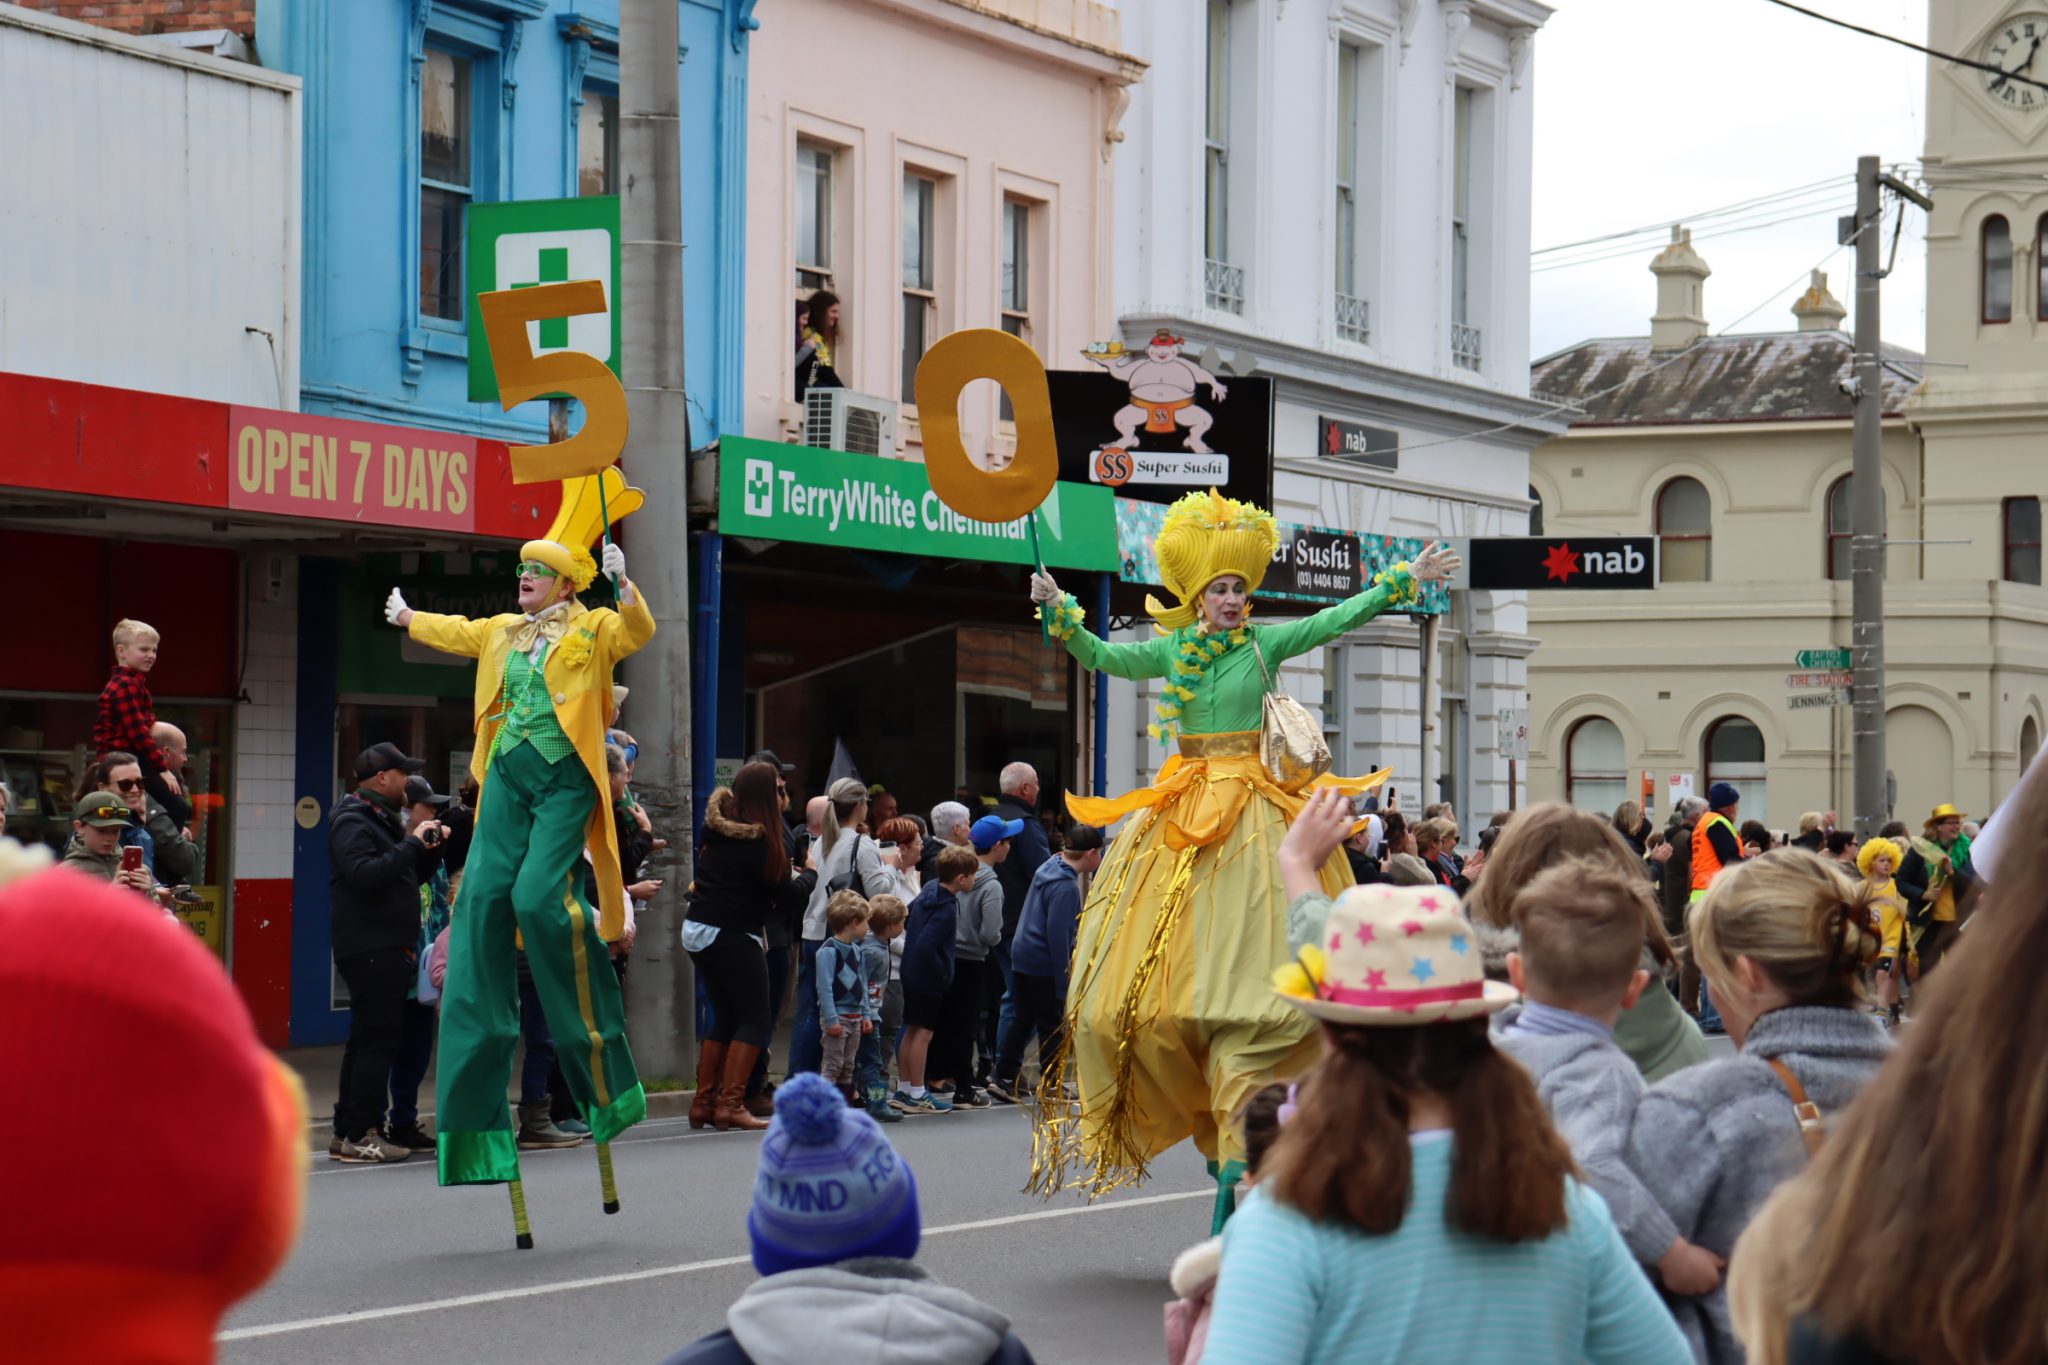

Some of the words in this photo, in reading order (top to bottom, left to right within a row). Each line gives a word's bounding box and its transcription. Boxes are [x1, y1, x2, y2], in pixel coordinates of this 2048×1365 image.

[478, 280, 629, 484] 5
[1345, 430, 1367, 452] nab
[238, 425, 337, 501] OPEN
[350, 440, 371, 504] 7
[384, 444, 467, 515] DAYS
[1102, 454, 1128, 479] SS
[1136, 460, 1180, 477] Super
[1183, 461, 1222, 475] Sushi
[778, 470, 917, 532] TerryWhite
[1296, 539, 1351, 571] Sushi
[1583, 544, 1645, 574] nab
[1297, 571, 1312, 590] (03)
[1313, 572, 1332, 586] 4404
[1333, 574, 1351, 590] 8637
[1790, 674, 1809, 687] FIRE
[1816, 673, 1853, 687] STATION
[1790, 693, 1838, 709] JENNINGS
[779, 1179, 848, 1213] MND
